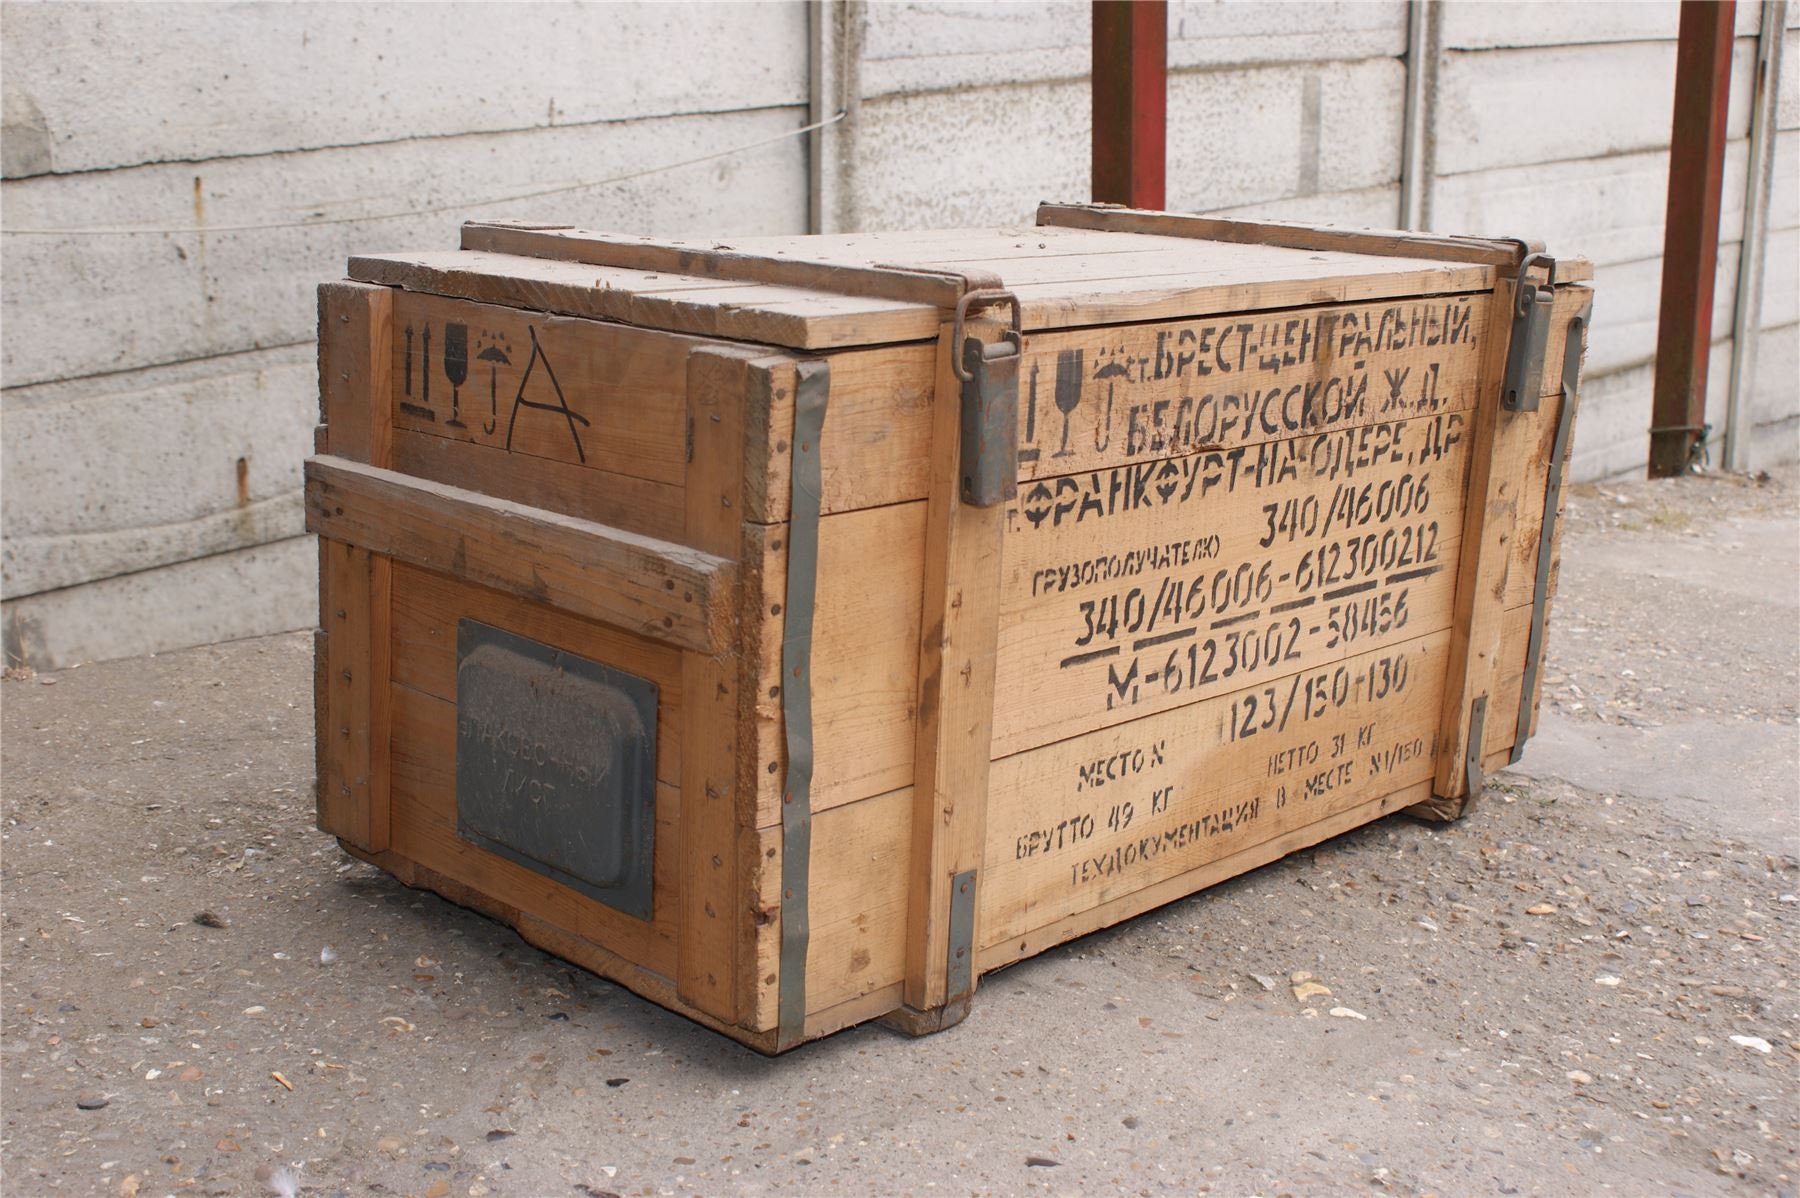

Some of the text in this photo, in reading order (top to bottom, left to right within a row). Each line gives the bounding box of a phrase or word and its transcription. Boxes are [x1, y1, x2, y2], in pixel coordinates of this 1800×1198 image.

[1126, 360, 1367, 457] БЕЛОРУССКОЙ
[1033, 472, 1430, 597] ГРУЗОПОЛУЧАТЕЛЮ 340/46006
[1075, 521, 1438, 646] 340/46006-612300212
[1016, 722, 1376, 859] БРУТТО 49 КГ НЕТТО 31 КГ
[1072, 797, 1259, 885] ТЕХДОКУМЕНТАЦИЯ
[1304, 760, 1353, 800] МЕСТЕ
[1077, 749, 1145, 792] МЕСТО
